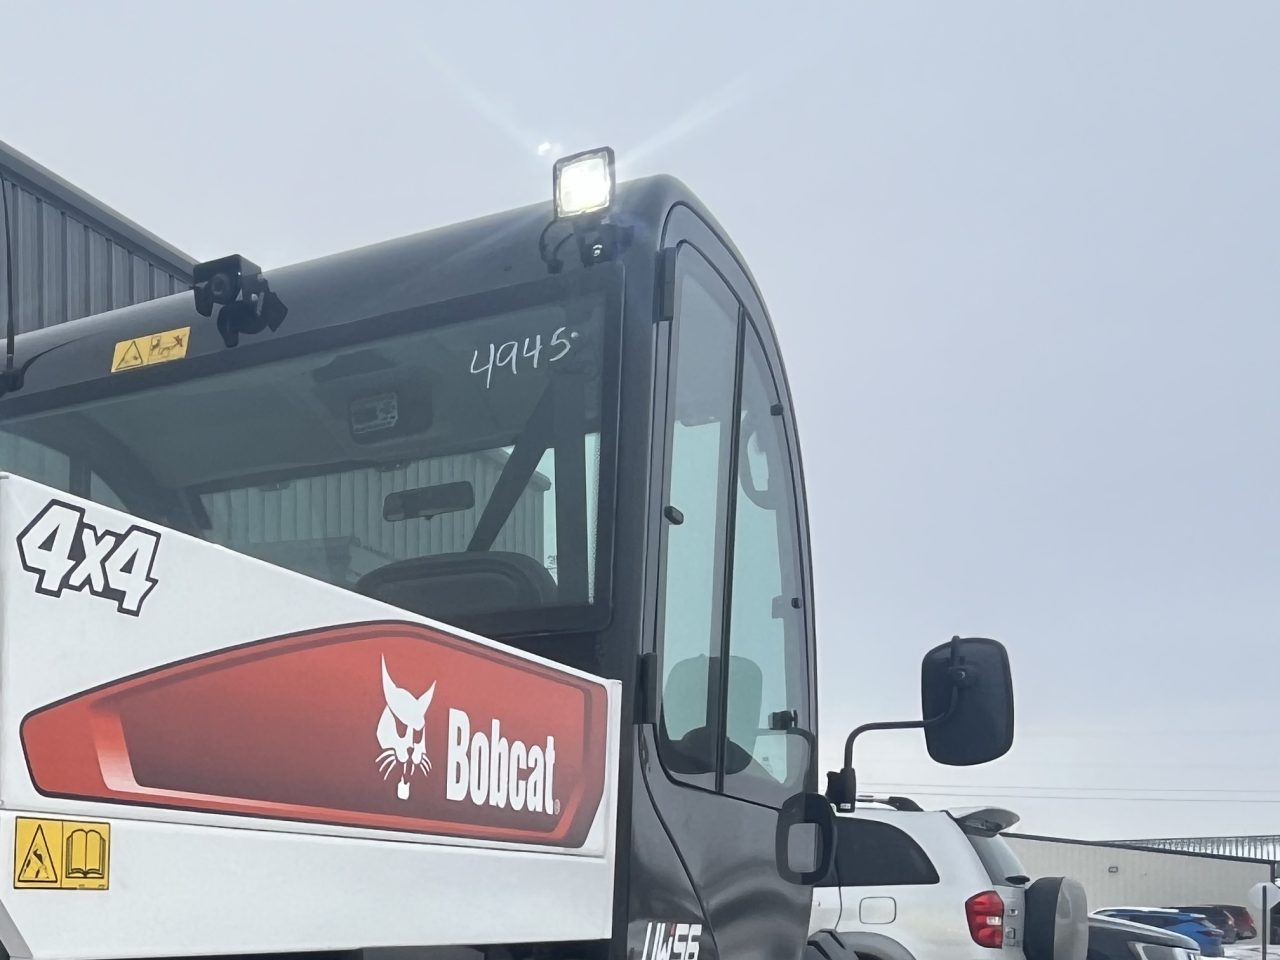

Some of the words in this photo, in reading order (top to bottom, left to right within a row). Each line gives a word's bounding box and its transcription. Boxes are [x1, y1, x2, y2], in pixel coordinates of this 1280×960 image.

[470, 327, 579, 389] 4945
[16, 498, 162, 617] 4x4
[446, 707, 556, 815] Bobcat
